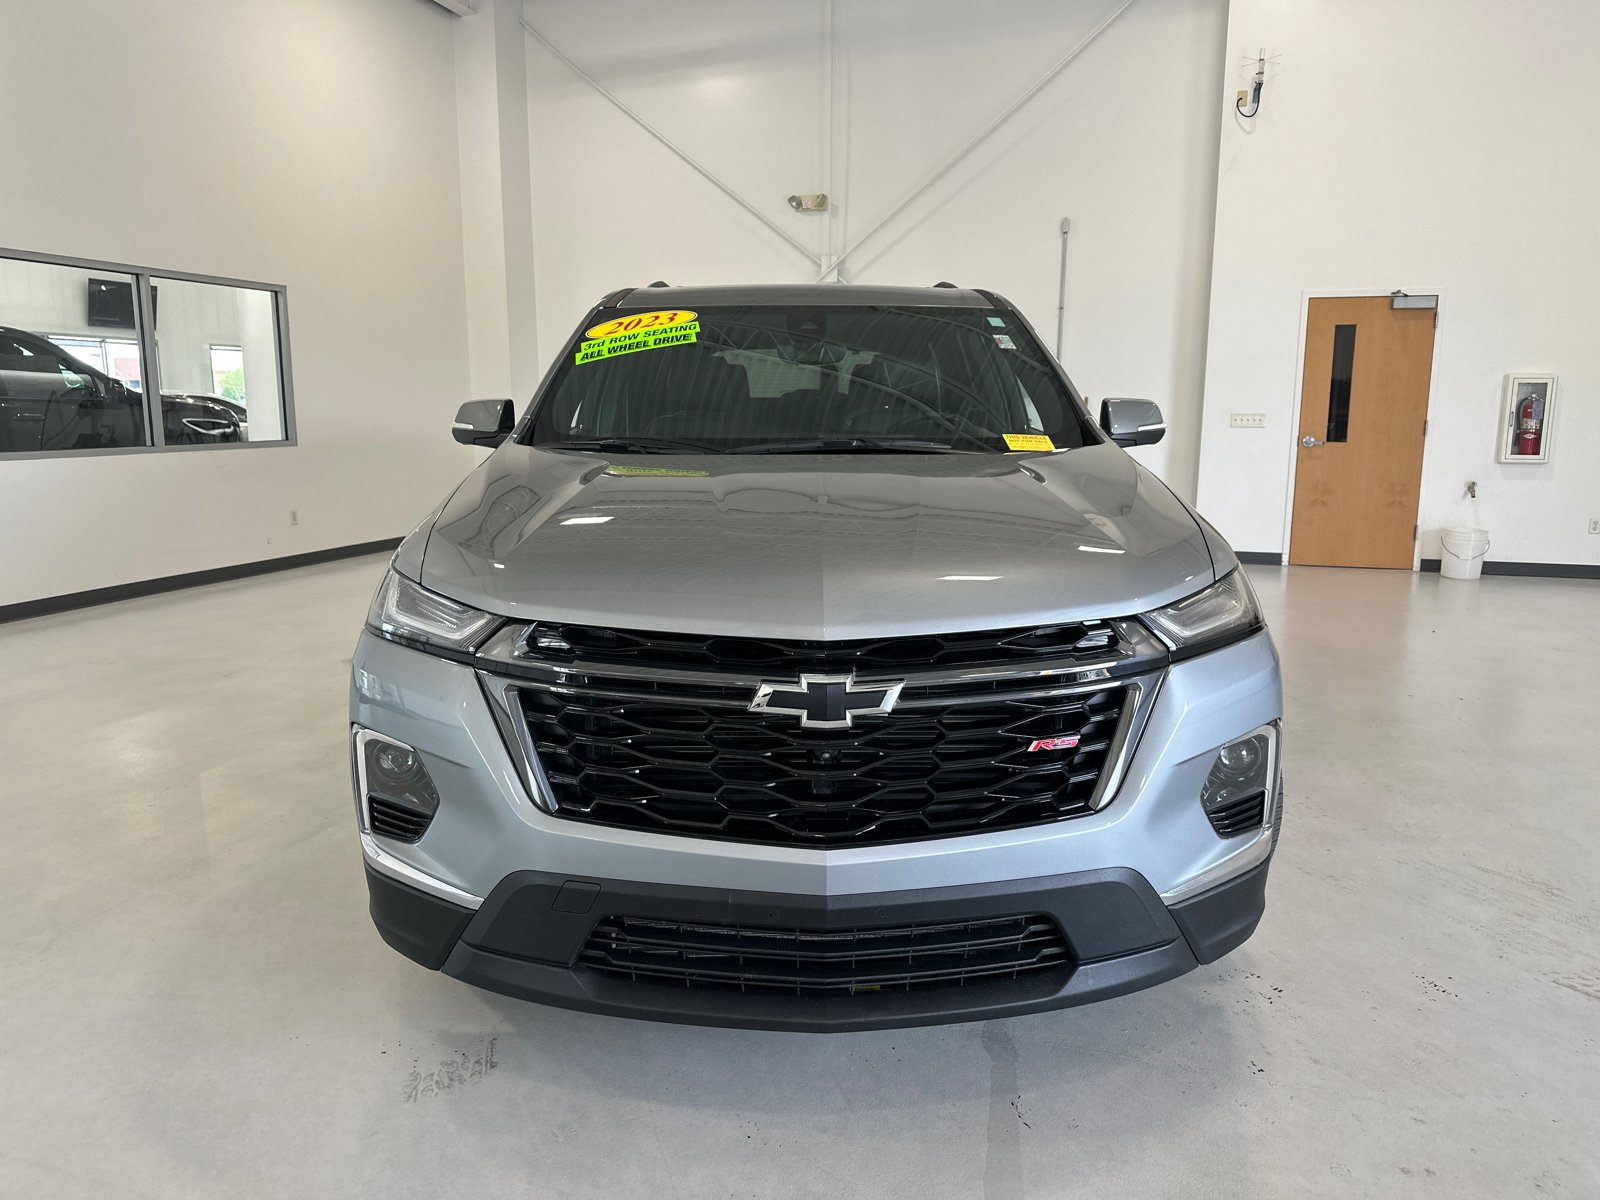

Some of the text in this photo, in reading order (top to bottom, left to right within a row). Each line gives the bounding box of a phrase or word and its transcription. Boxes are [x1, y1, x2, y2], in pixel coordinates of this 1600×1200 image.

[583, 323, 697, 351] 3rd ROW SEATING
[603, 312, 679, 336] 2023
[579, 333, 693, 362] ALL WHEEL DRIVE
[1027, 736, 1081, 751] RS
